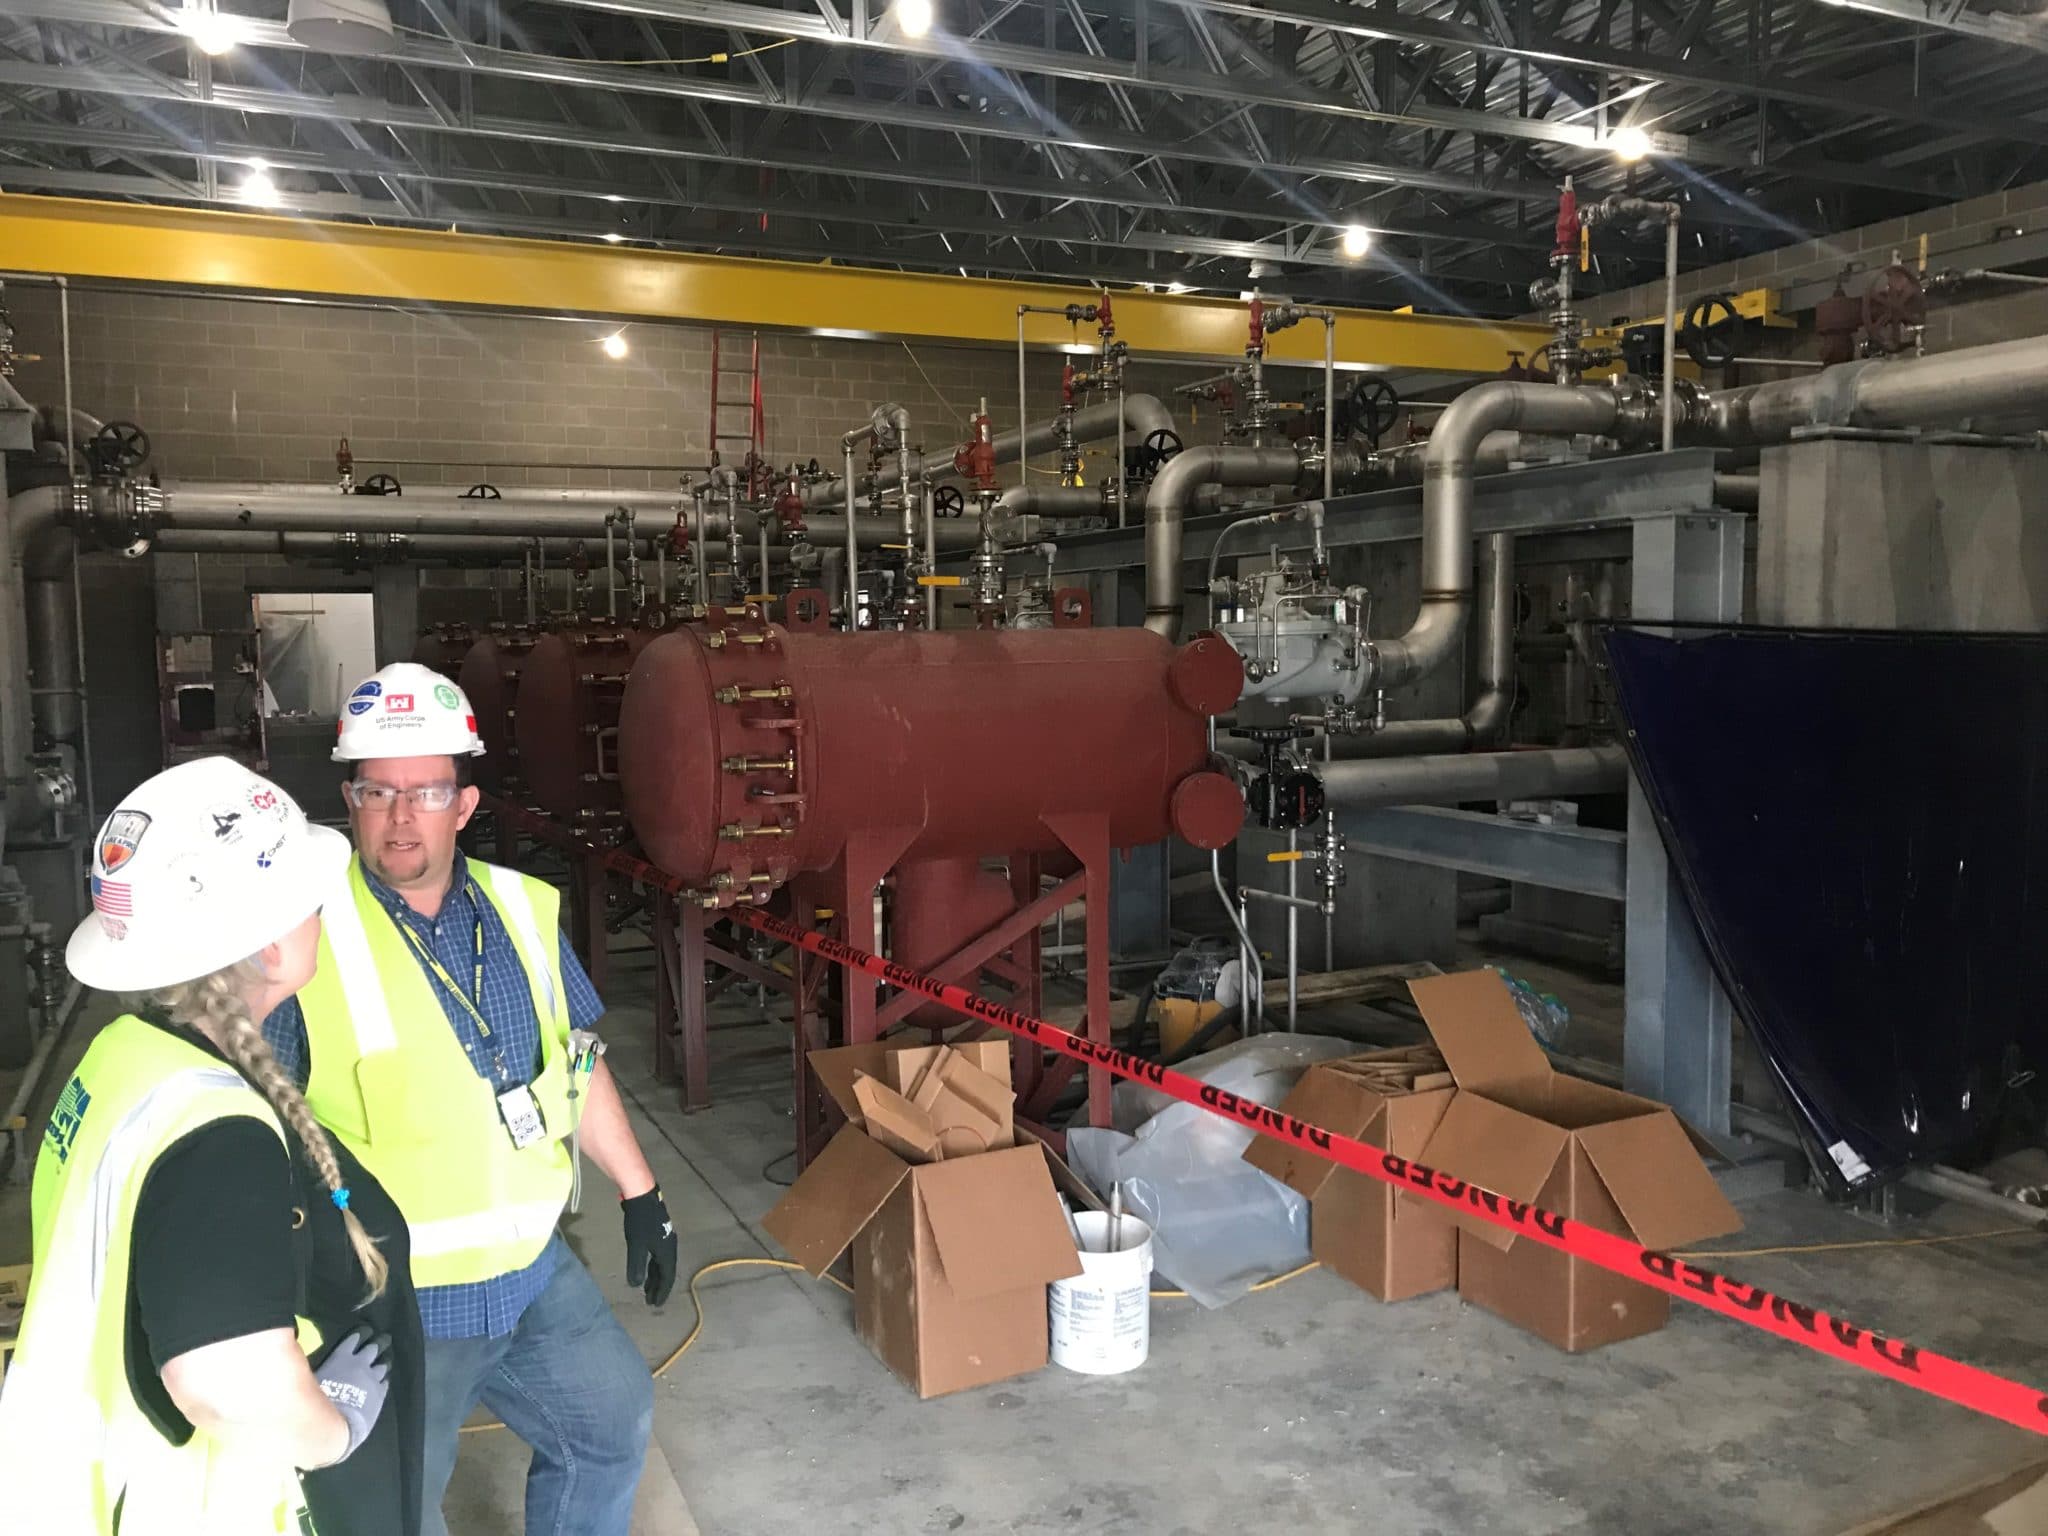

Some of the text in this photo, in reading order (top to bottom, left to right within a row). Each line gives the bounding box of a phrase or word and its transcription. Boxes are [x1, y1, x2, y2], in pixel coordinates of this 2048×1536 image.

[882, 963, 945, 998] DANGER
[964, 994, 1040, 1035] DANGER
[1066, 1035, 1165, 1085] DANGER
[1200, 1085, 1331, 1150] DANGER
[1381, 1154, 1566, 1239] DANGER
